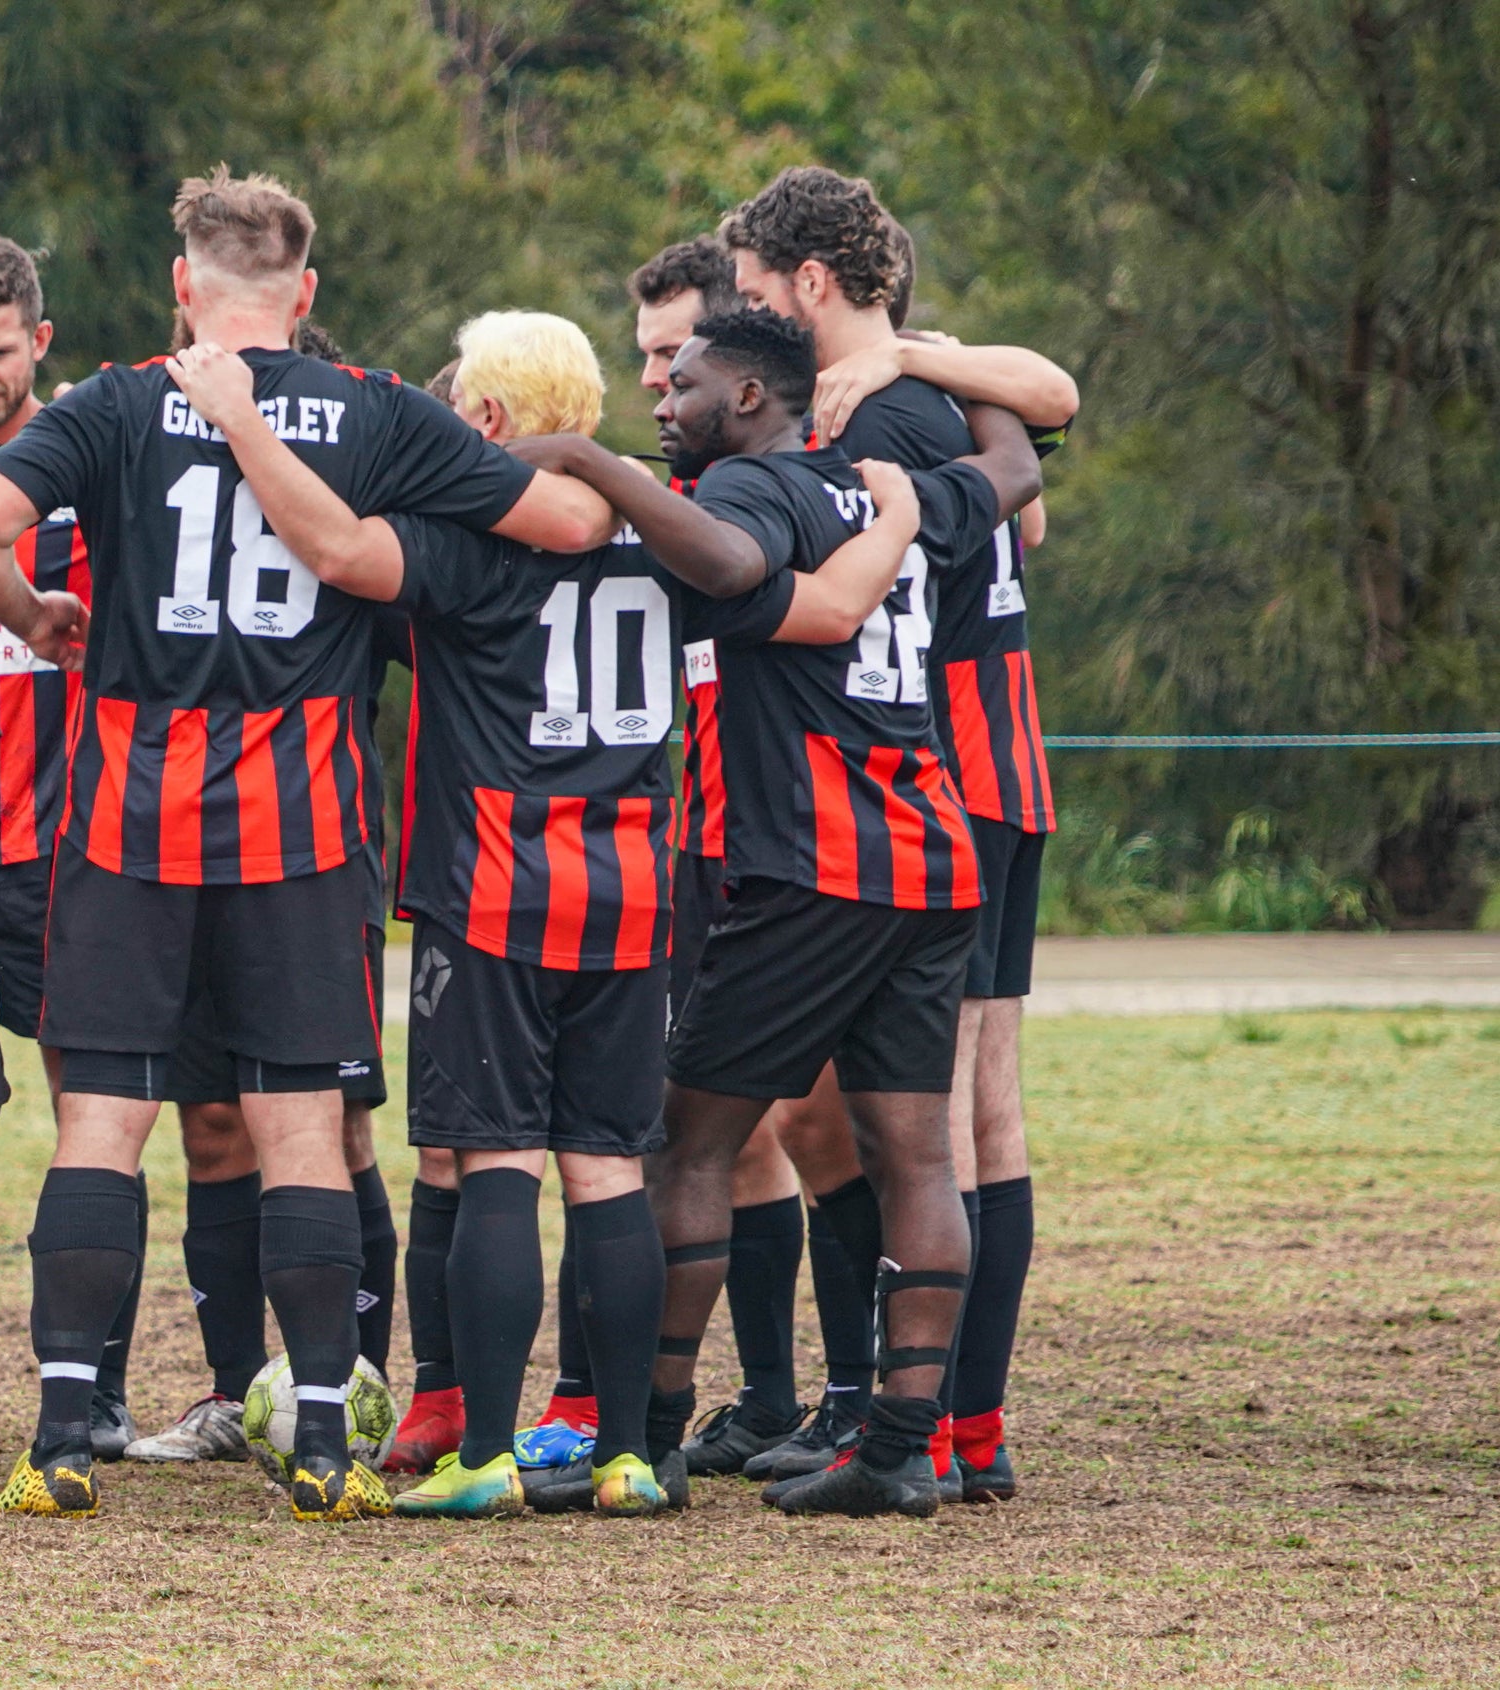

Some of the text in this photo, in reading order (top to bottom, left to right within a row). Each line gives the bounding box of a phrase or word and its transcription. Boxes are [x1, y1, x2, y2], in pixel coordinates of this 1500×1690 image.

[157, 464, 320, 638] 18
[173, 621, 203, 630] umbro
[529, 576, 673, 747] 10
